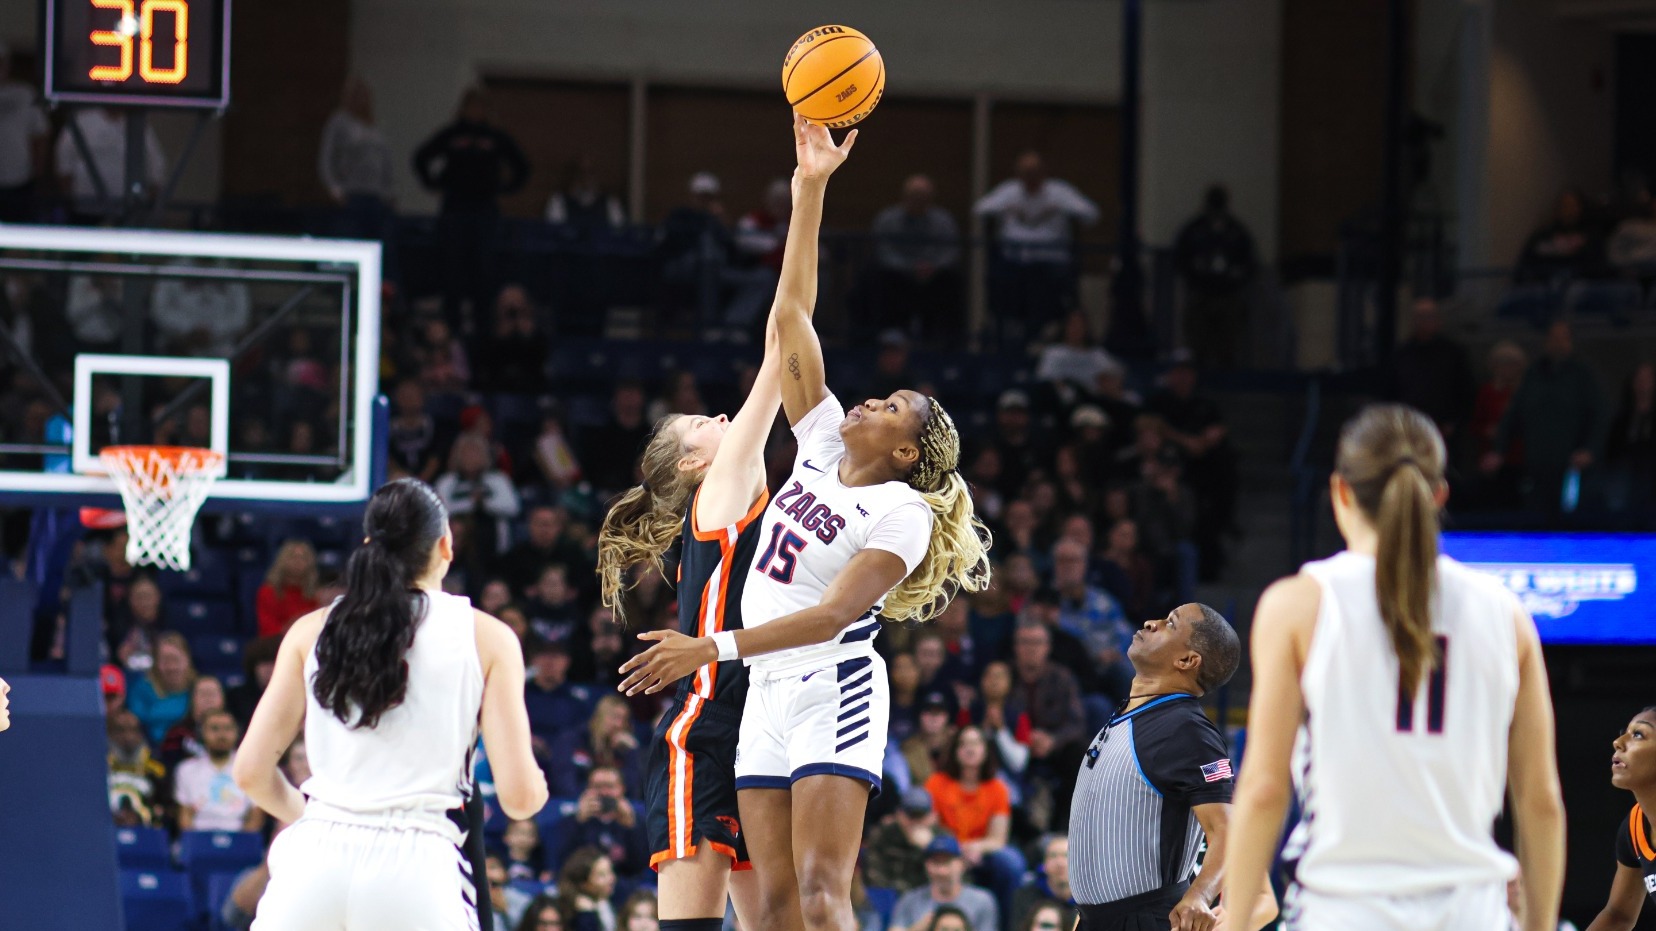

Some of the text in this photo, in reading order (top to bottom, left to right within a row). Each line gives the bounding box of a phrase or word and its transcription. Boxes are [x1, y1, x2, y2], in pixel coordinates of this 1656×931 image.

[89, 0, 188, 84] 30
[836, 84, 857, 102] ZAGS
[775, 480, 846, 546] ZAGS
[755, 521, 808, 585] 15
